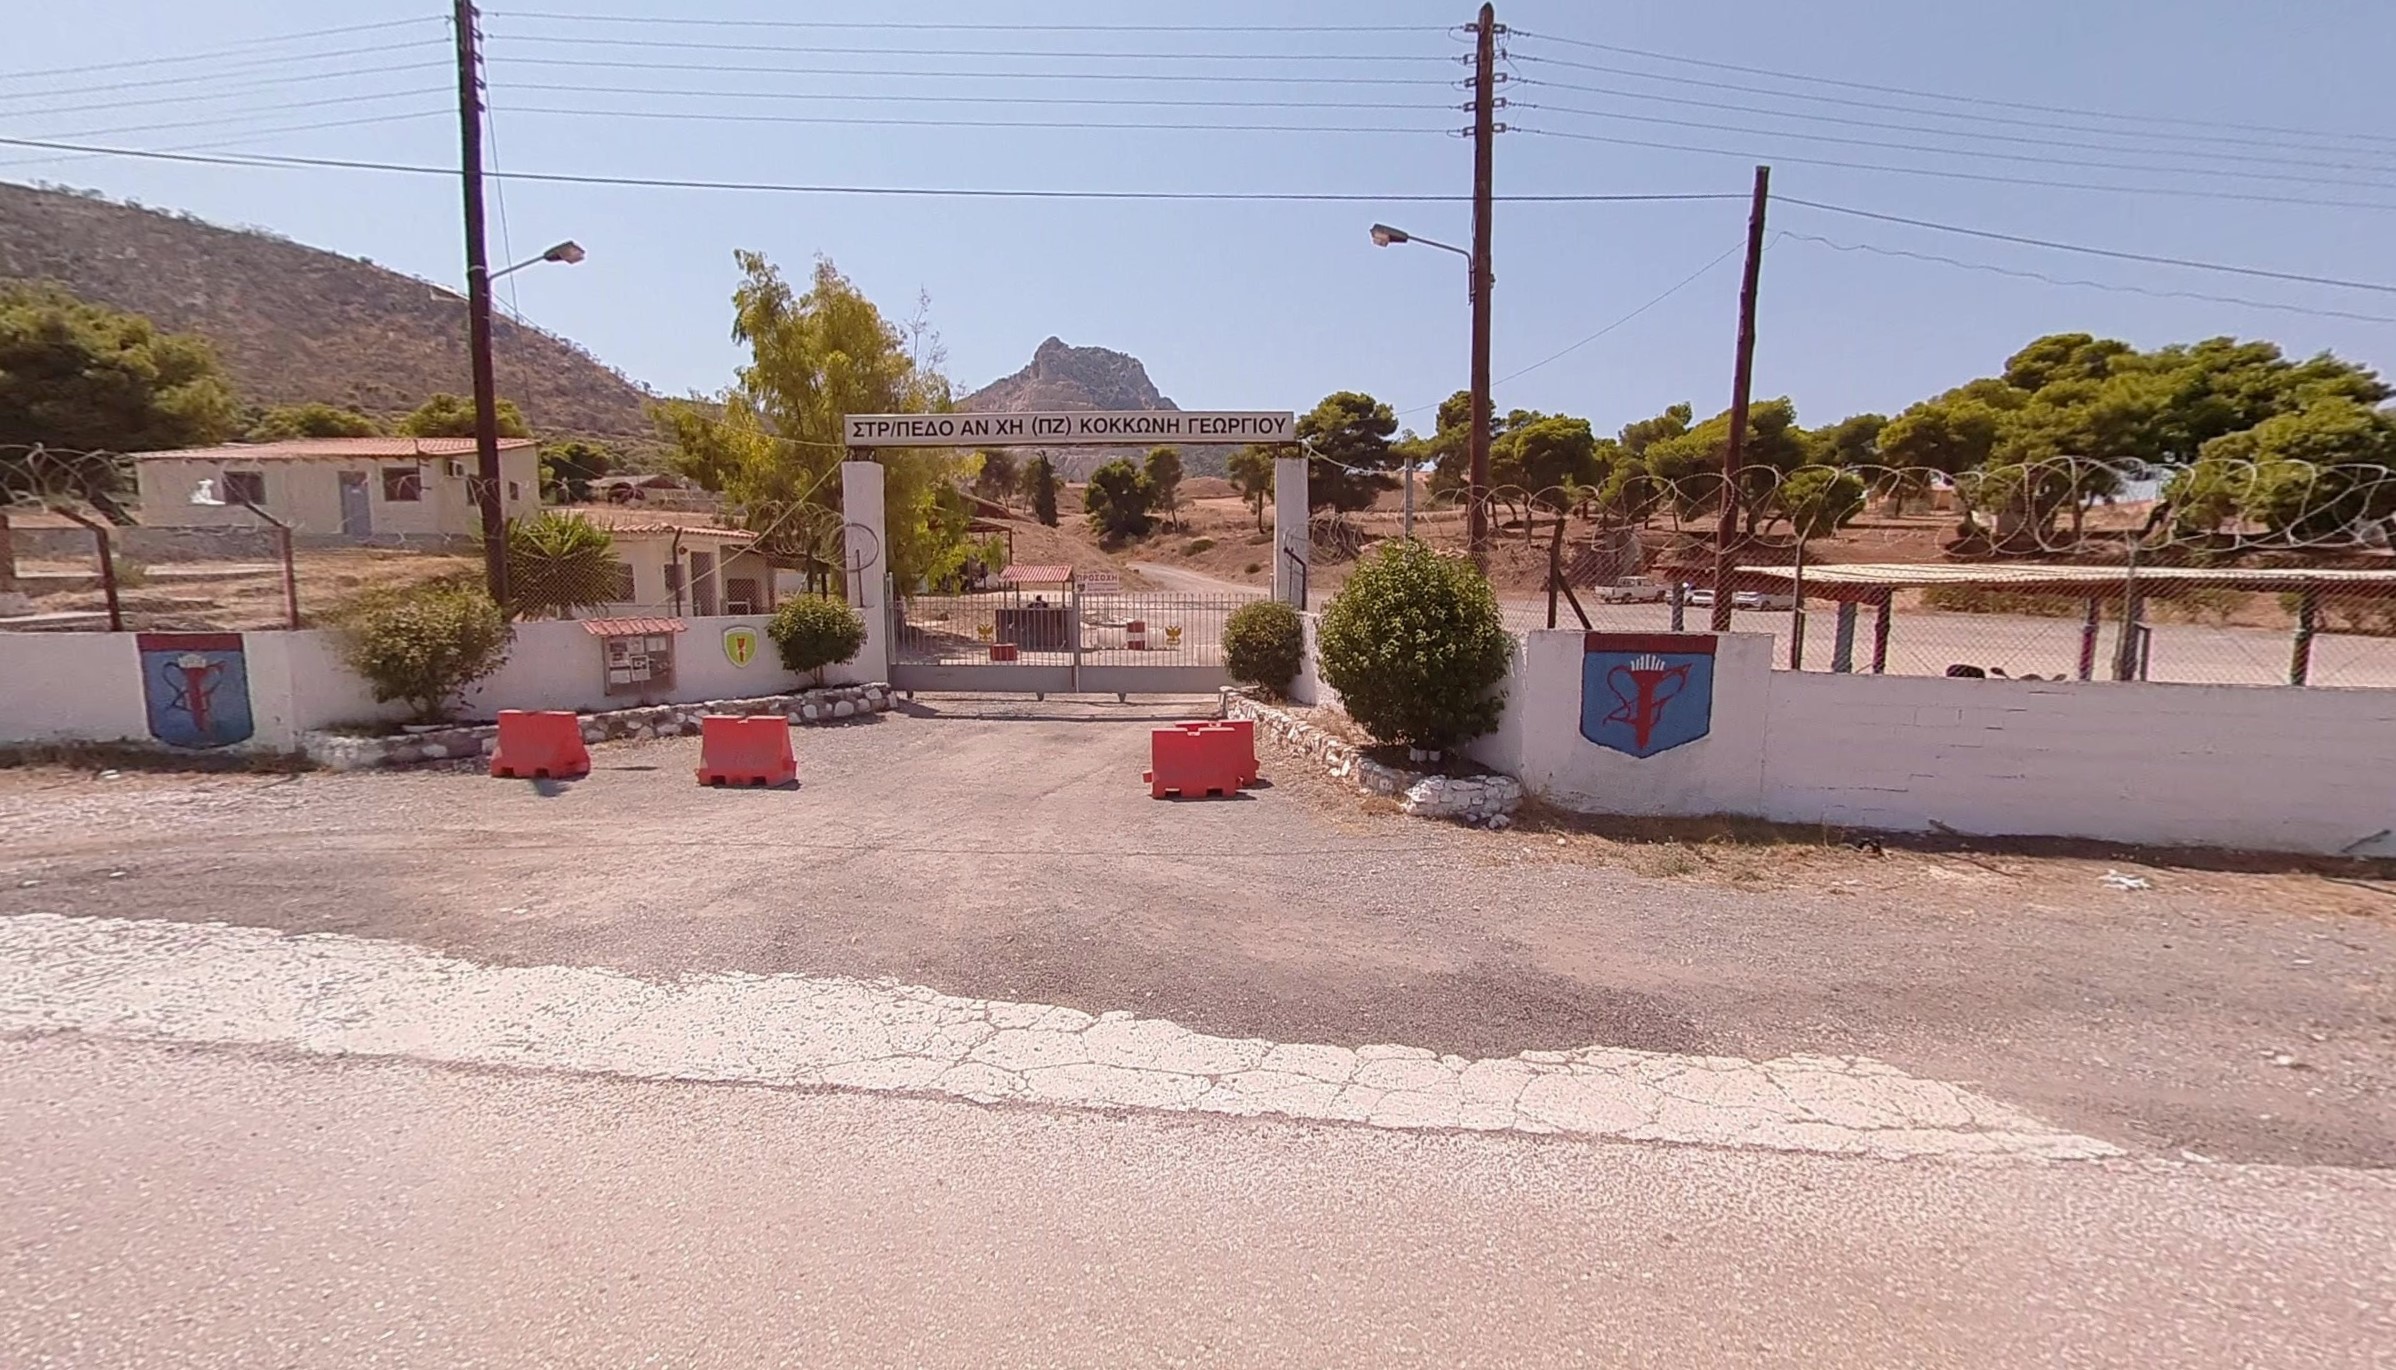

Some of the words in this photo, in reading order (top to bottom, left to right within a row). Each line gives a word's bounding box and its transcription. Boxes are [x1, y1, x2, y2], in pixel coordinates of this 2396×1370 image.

[852, 420, 954, 437] ΣΤΡ/ΠΕΔΟ
[960, 419, 989, 436] ΑΝ
[995, 419, 1023, 435] ΧΗ
[1031, 416, 1072, 436] (ΠΖ)
[1080, 417, 1180, 434] ΚΟΚΚΩΝΗ
[1188, 417, 1286, 434] ΓΕΩΡΓΙΟΥ
[1076, 574, 1118, 582] ΠΡΟΣΟΧΗ
